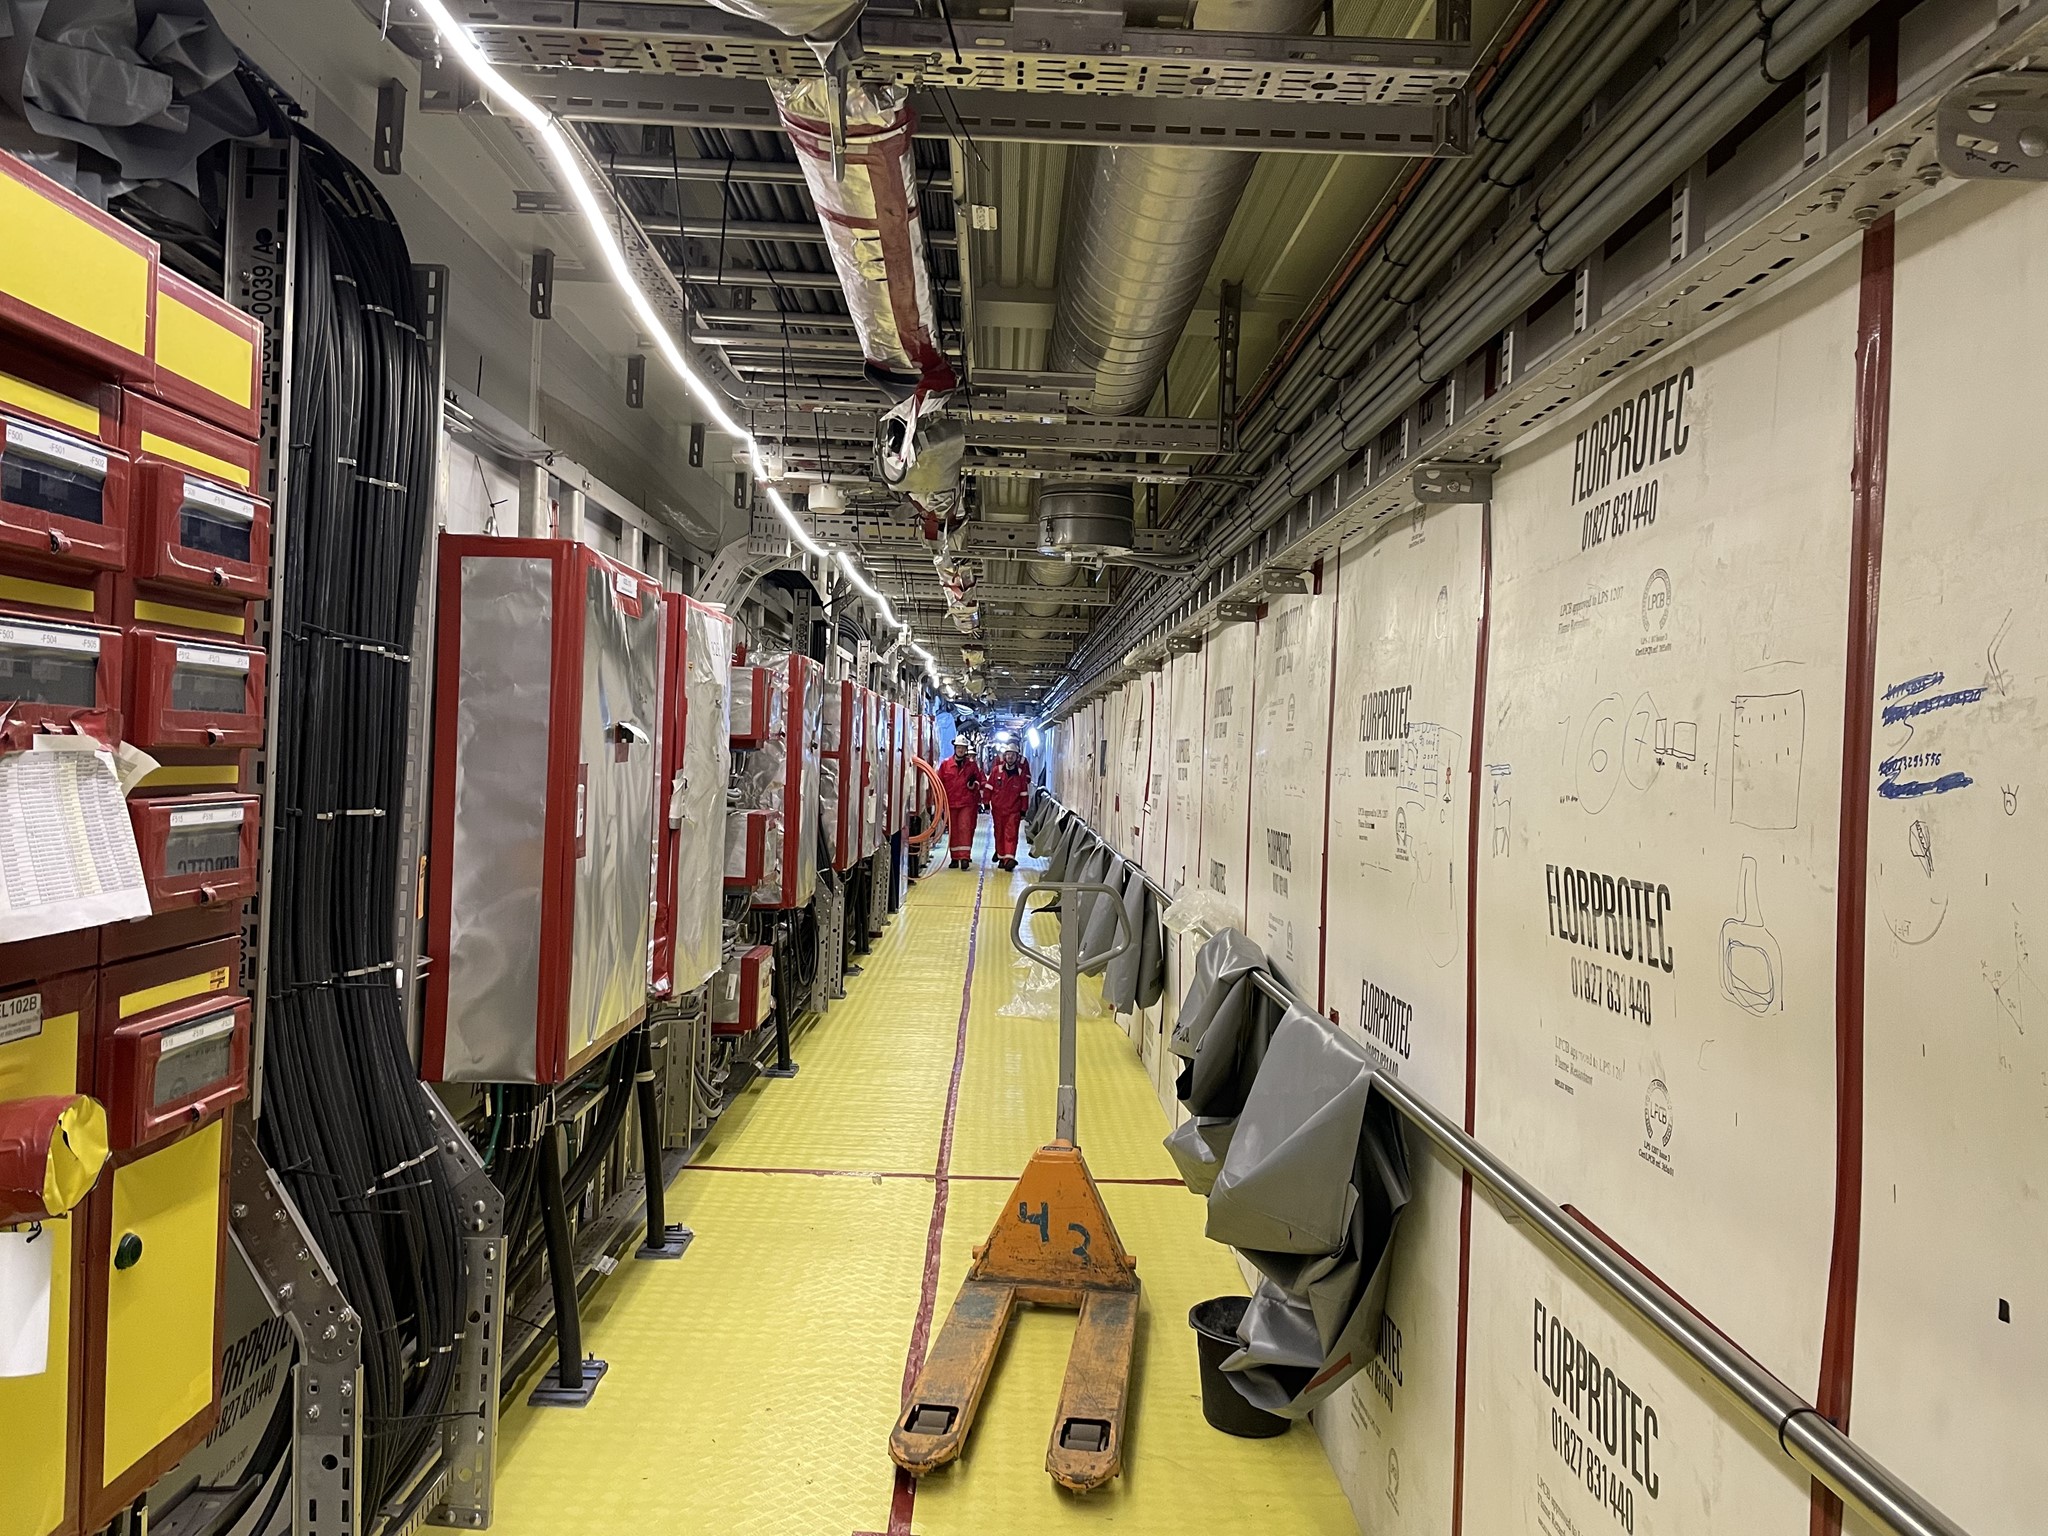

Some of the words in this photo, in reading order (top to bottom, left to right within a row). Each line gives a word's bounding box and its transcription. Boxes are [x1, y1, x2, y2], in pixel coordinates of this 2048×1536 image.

[1571, 365, 1695, 507] FLORPROTEC
[1581, 499, 1611, 552] 01827
[1611, 479, 1658, 540] 831440
[1648, 591, 1665, 610] LPCB
[1359, 685, 1412, 742] FLORPROTEC
[1545, 863, 1673, 974] FLORPROTEC
[0, 996, 37, 1019] L102B
[1360, 978, 1413, 1060] FLORPROTEC
[1570, 956, 1603, 1007] 01827
[1606, 968, 1652, 1026] 831440
[240, 1363, 278, 1421] 831440
[1534, 1297, 1659, 1500] FLORPROTEC
[1551, 1406, 1583, 1480] 01827
[1586, 1447, 1634, 1536] 831440
